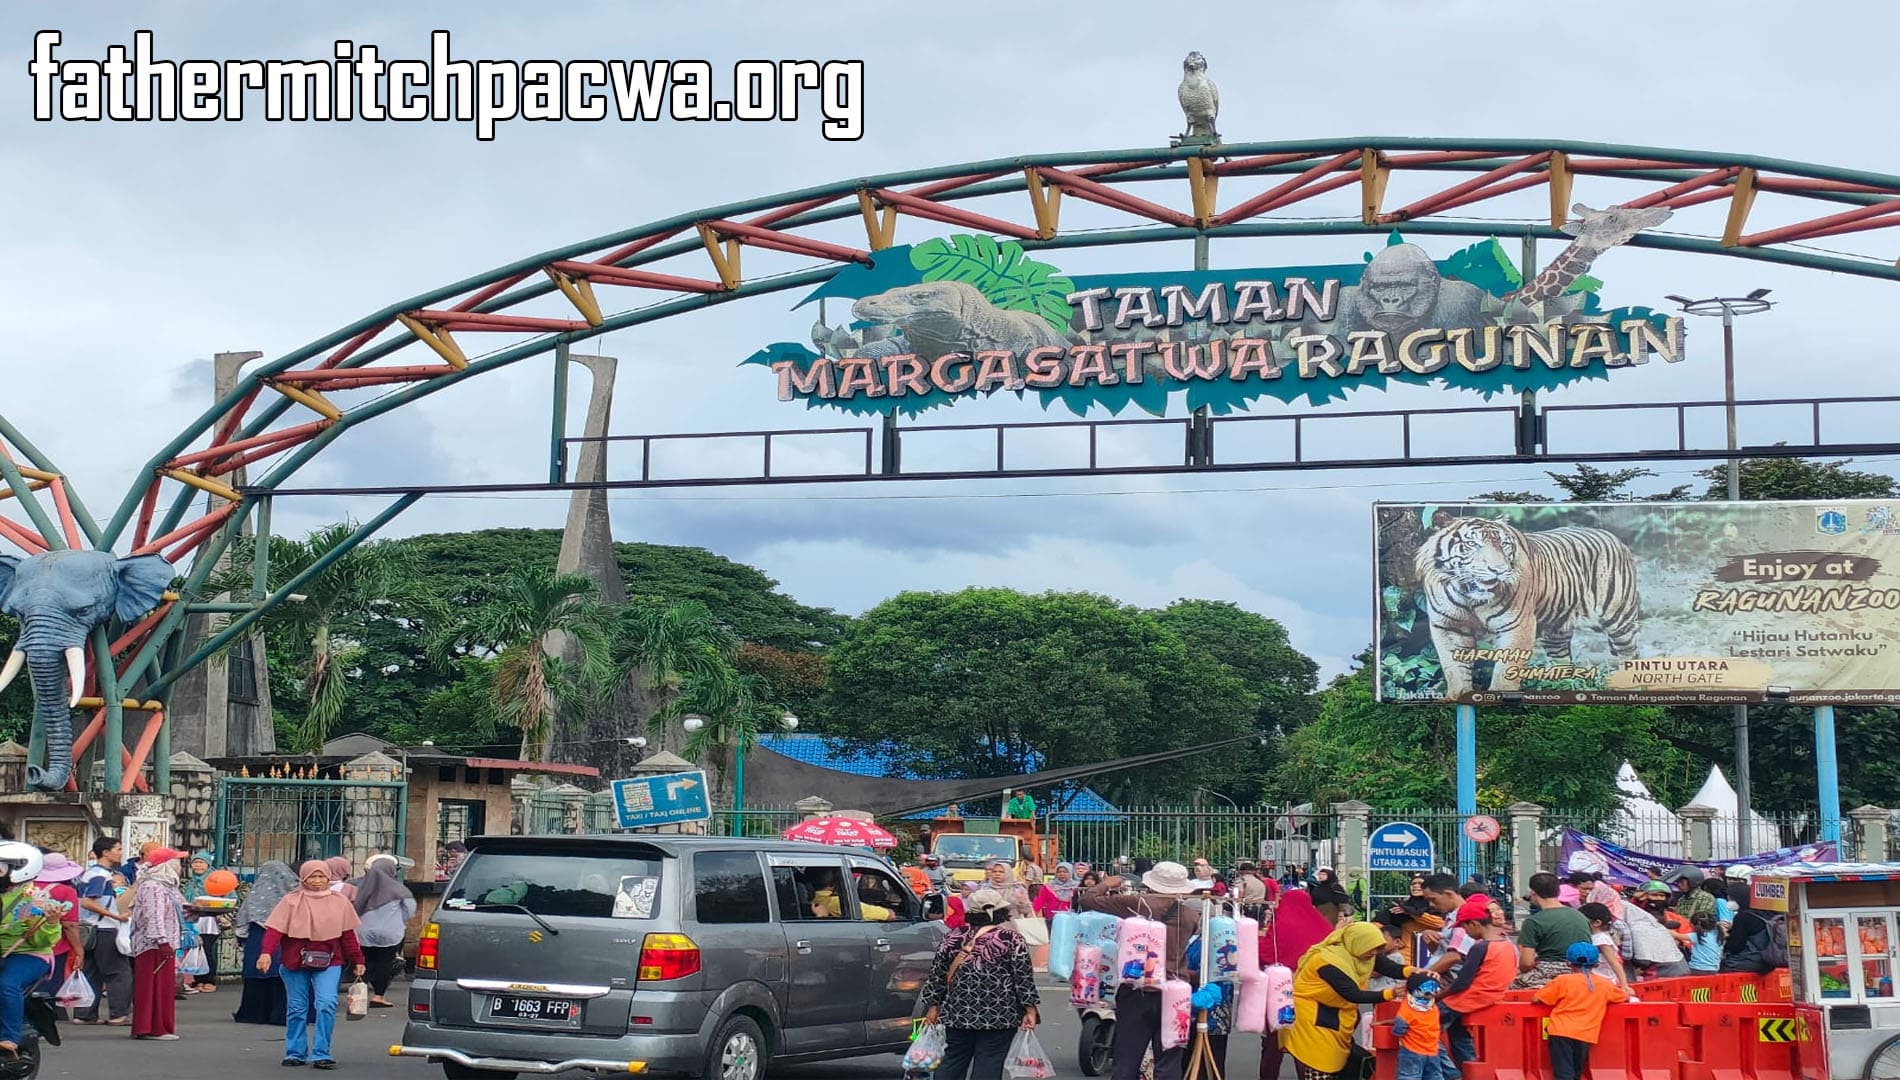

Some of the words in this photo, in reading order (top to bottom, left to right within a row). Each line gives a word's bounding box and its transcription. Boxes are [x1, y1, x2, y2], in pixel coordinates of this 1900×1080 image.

[1066, 276, 1342, 332] TAMAN
[772, 337, 1284, 402] MARGASATWA
[1290, 315, 1687, 379] RAGUNAN
[1743, 558, 1818, 580] Enjoy
[1825, 559, 1854, 576] at
[1693, 584, 1900, 615] RAGUNANZOO
[1794, 629, 1873, 643] Hutanku
[1452, 647, 1534, 663] HARIMAU
[1729, 645, 1791, 658] Lestari
[1504, 664, 1598, 682] SUMATERA
[1624, 660, 1672, 672] PINTU
[1677, 660, 1729, 672] UTARA
[1632, 672, 1683, 684] NORTH
[1687, 672, 1724, 684] GATE
[1591, 693, 1624, 701] Taman
[1628, 693, 1697, 703] Margasatwa
[1699, 693, 1748, 703] Ragunan
[650, 810, 668, 819] TAXI
[669, 806, 702, 816] ONLINE
[1370, 847, 1396, 857] PINTU
[1396, 847, 1430, 857] MASUK
[1373, 858, 1403, 867] UTARA
[1755, 883, 1786, 899] LUMBER
[493, 998, 503, 1010] B
[512, 999, 542, 1013] 1663
[546, 1000, 570, 1015] FFP
